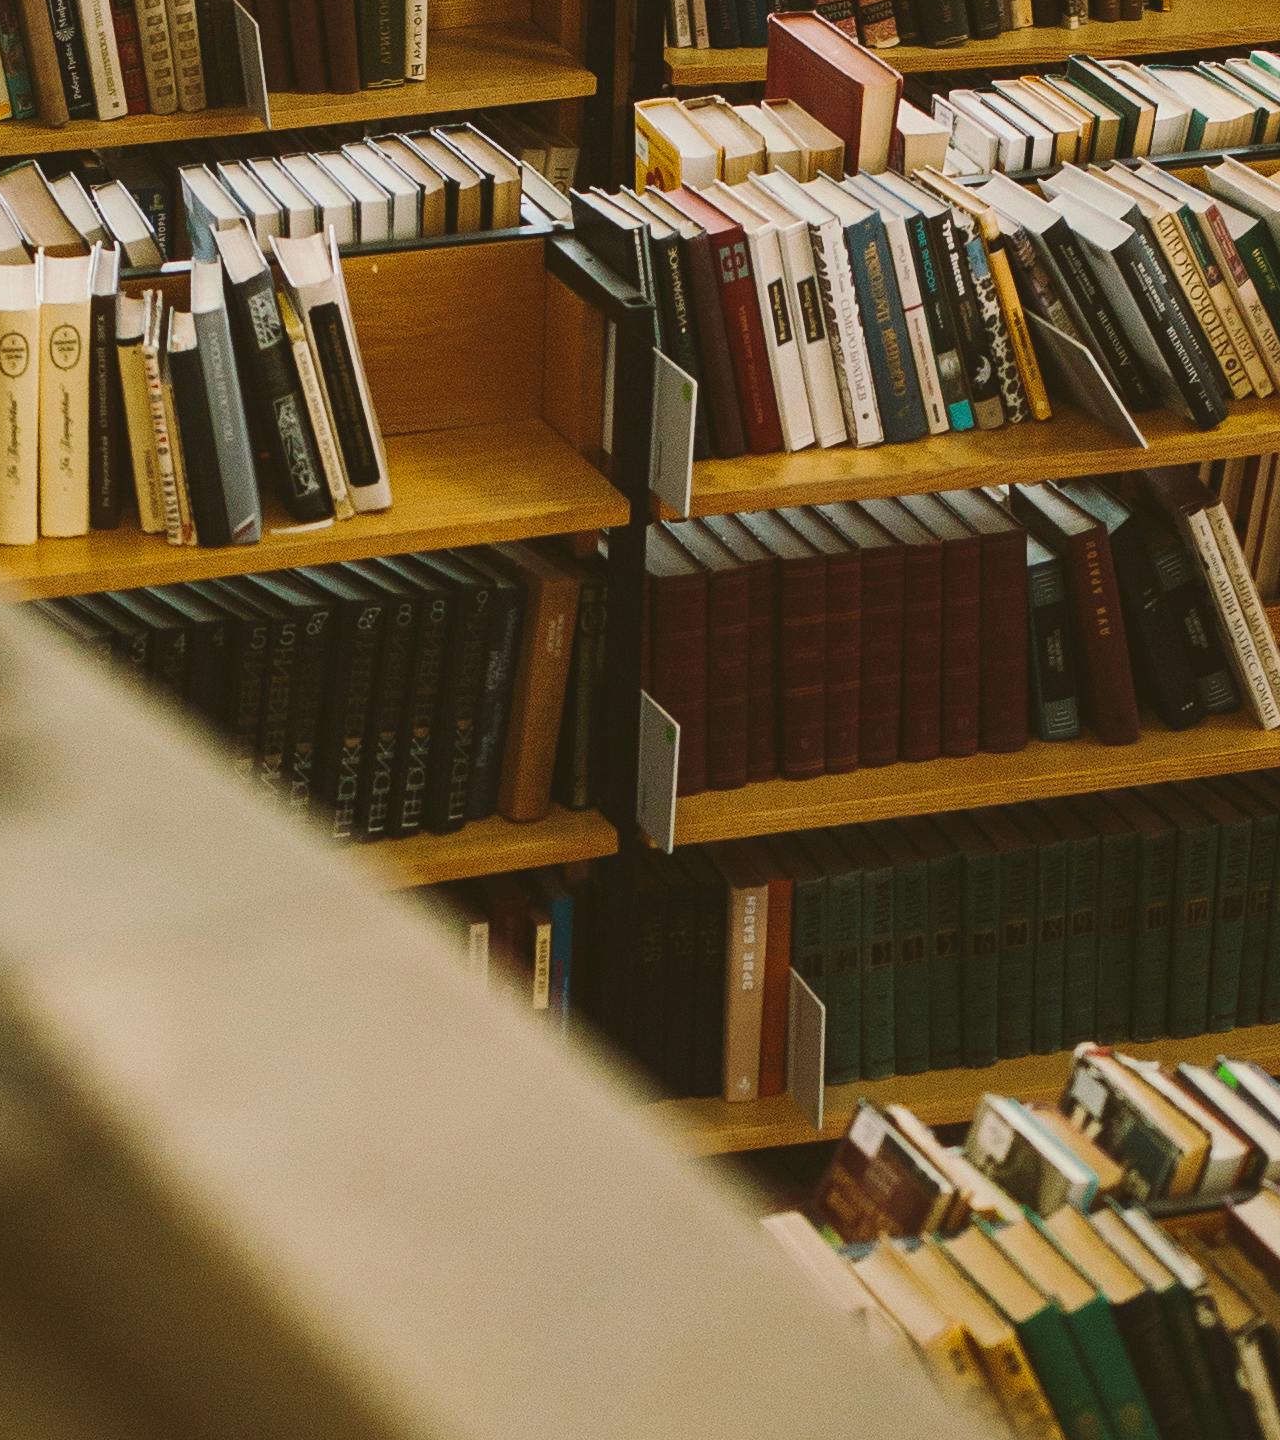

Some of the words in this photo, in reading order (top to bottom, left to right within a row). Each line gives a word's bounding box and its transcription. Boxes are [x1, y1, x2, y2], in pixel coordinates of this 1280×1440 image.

[70, 72, 82, 100] Роберт
[915, 220, 928, 243] ТУВЕ
[921, 250, 938, 293] ЯНССОН
[941, 220, 957, 249] Туве
[949, 252, 966, 296] Янссон
[667, 246, 688, 326] ИЗБРАННОЕ
[1157, 214, 1230, 357] АНТОКОЛЬСКИЙ
[840, 298, 858, 349] СЕМЕРО
[850, 350, 867, 401] БРАТЬЕВ
[1096, 310, 1131, 367] Антология
[1166, 325, 1200, 385] Антология
[1232, 328, 1256, 361] АНУЙ
[1086, 540, 1105, 595] АРАГОН
[1235, 572, 1257, 611] АНРИ
[396, 604, 412, 626] 8
[429, 601, 446, 624] 8
[1095, 605, 1111, 636] ЛУИ
[250, 627, 266, 649] 5
[279, 623, 296, 646] 5
[1218, 579, 1239, 616] АНРИ
[1252, 675, 1276, 721] РОМАН
[743, 895, 757, 944] БАЗЕН
[742, 951, 755, 990] ЭРВЕ
